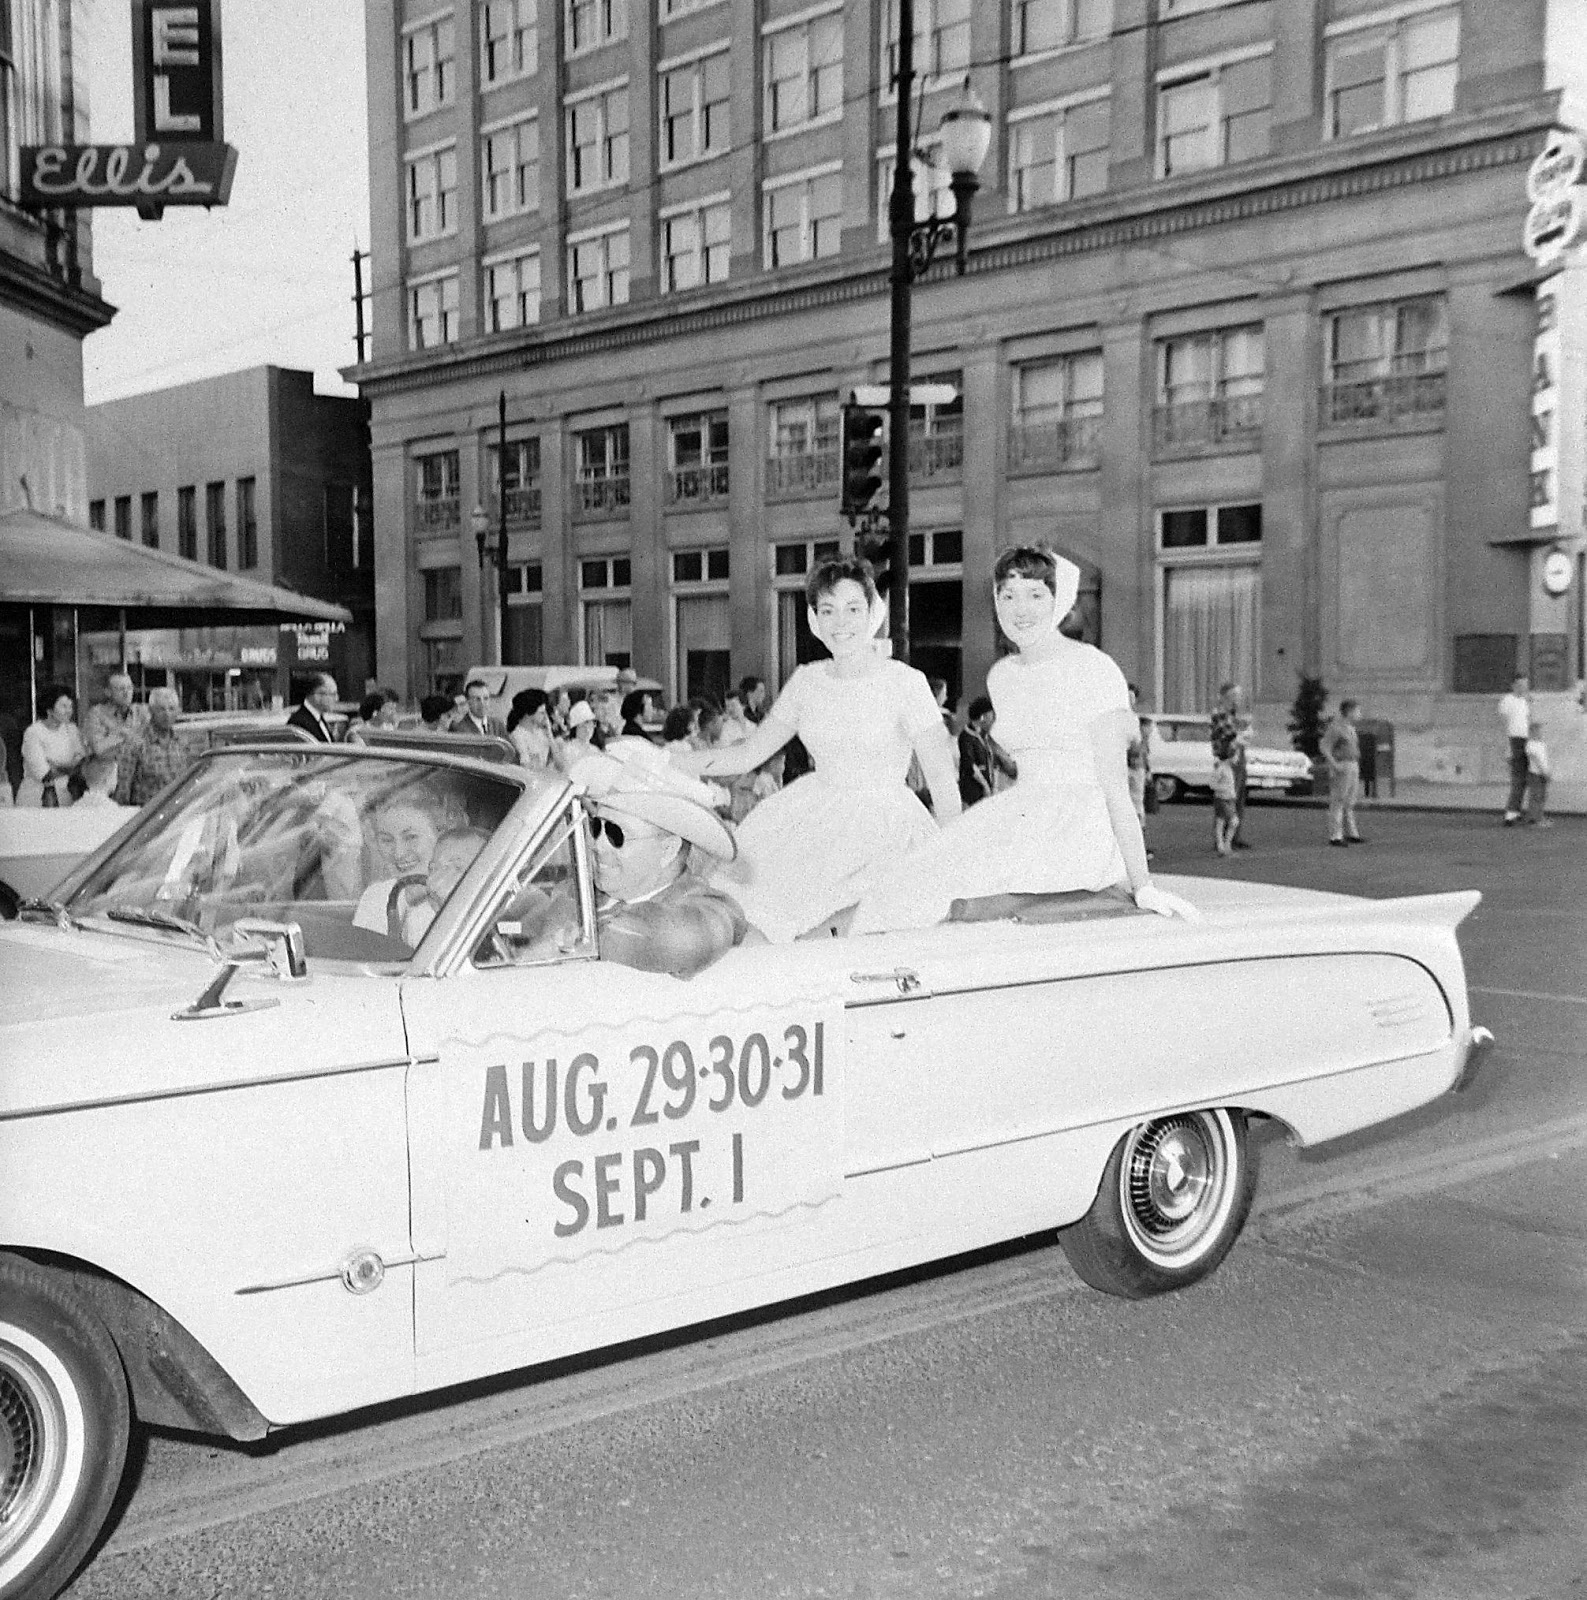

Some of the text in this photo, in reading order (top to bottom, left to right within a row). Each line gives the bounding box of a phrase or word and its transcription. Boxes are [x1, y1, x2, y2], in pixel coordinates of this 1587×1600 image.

[32, 143, 213, 195] Ellis
[478, 1052, 618, 1151] AUG.
[551, 1132, 744, 1239] SEPT. 1
